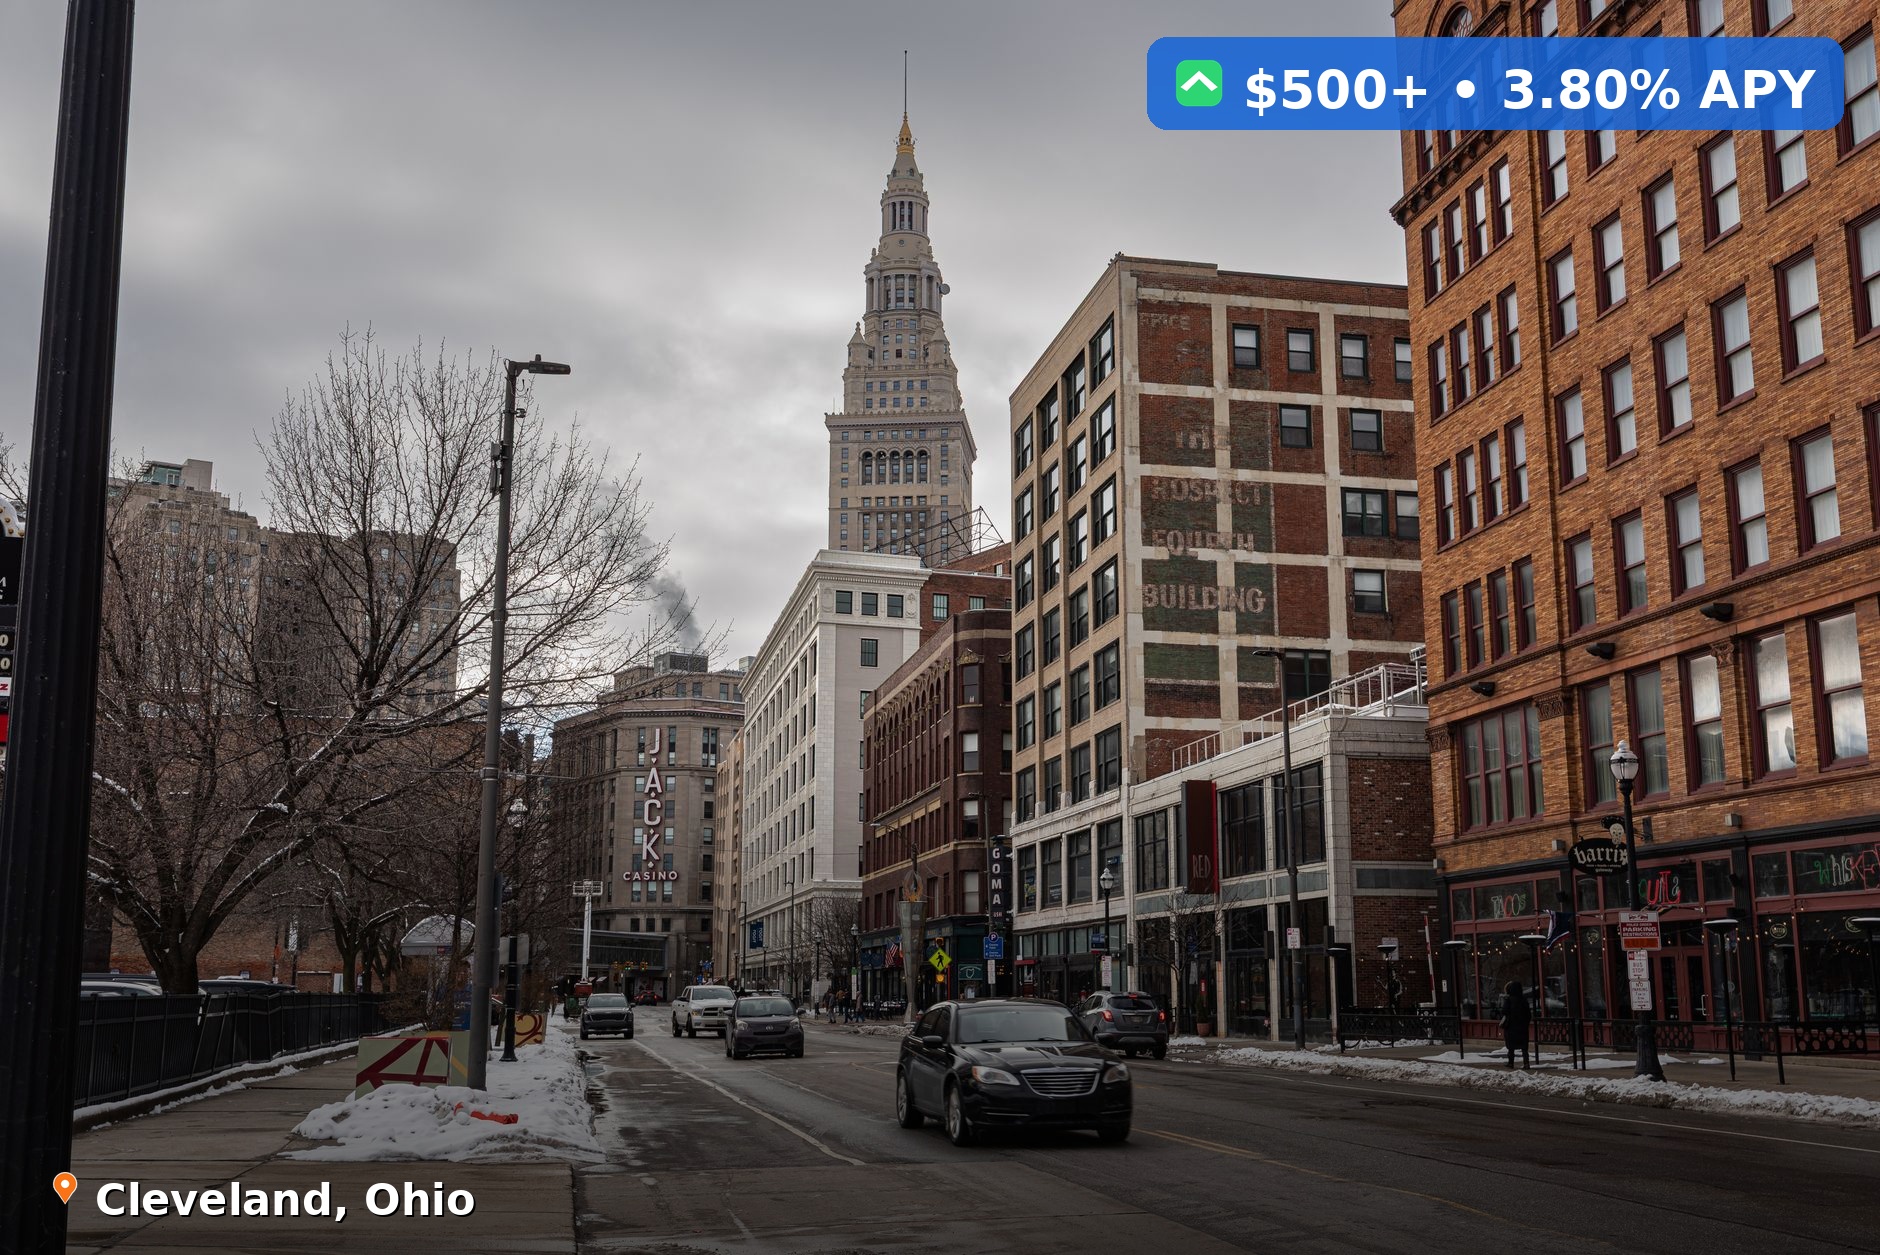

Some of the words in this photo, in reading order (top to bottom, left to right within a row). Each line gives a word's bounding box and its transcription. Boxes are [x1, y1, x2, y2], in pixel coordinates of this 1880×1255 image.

[642, 727, 663, 861] JACK
[622, 870, 679, 882] CASINO
[991, 848, 1002, 905] GOMA
[1192, 855, 1212, 879] RED
